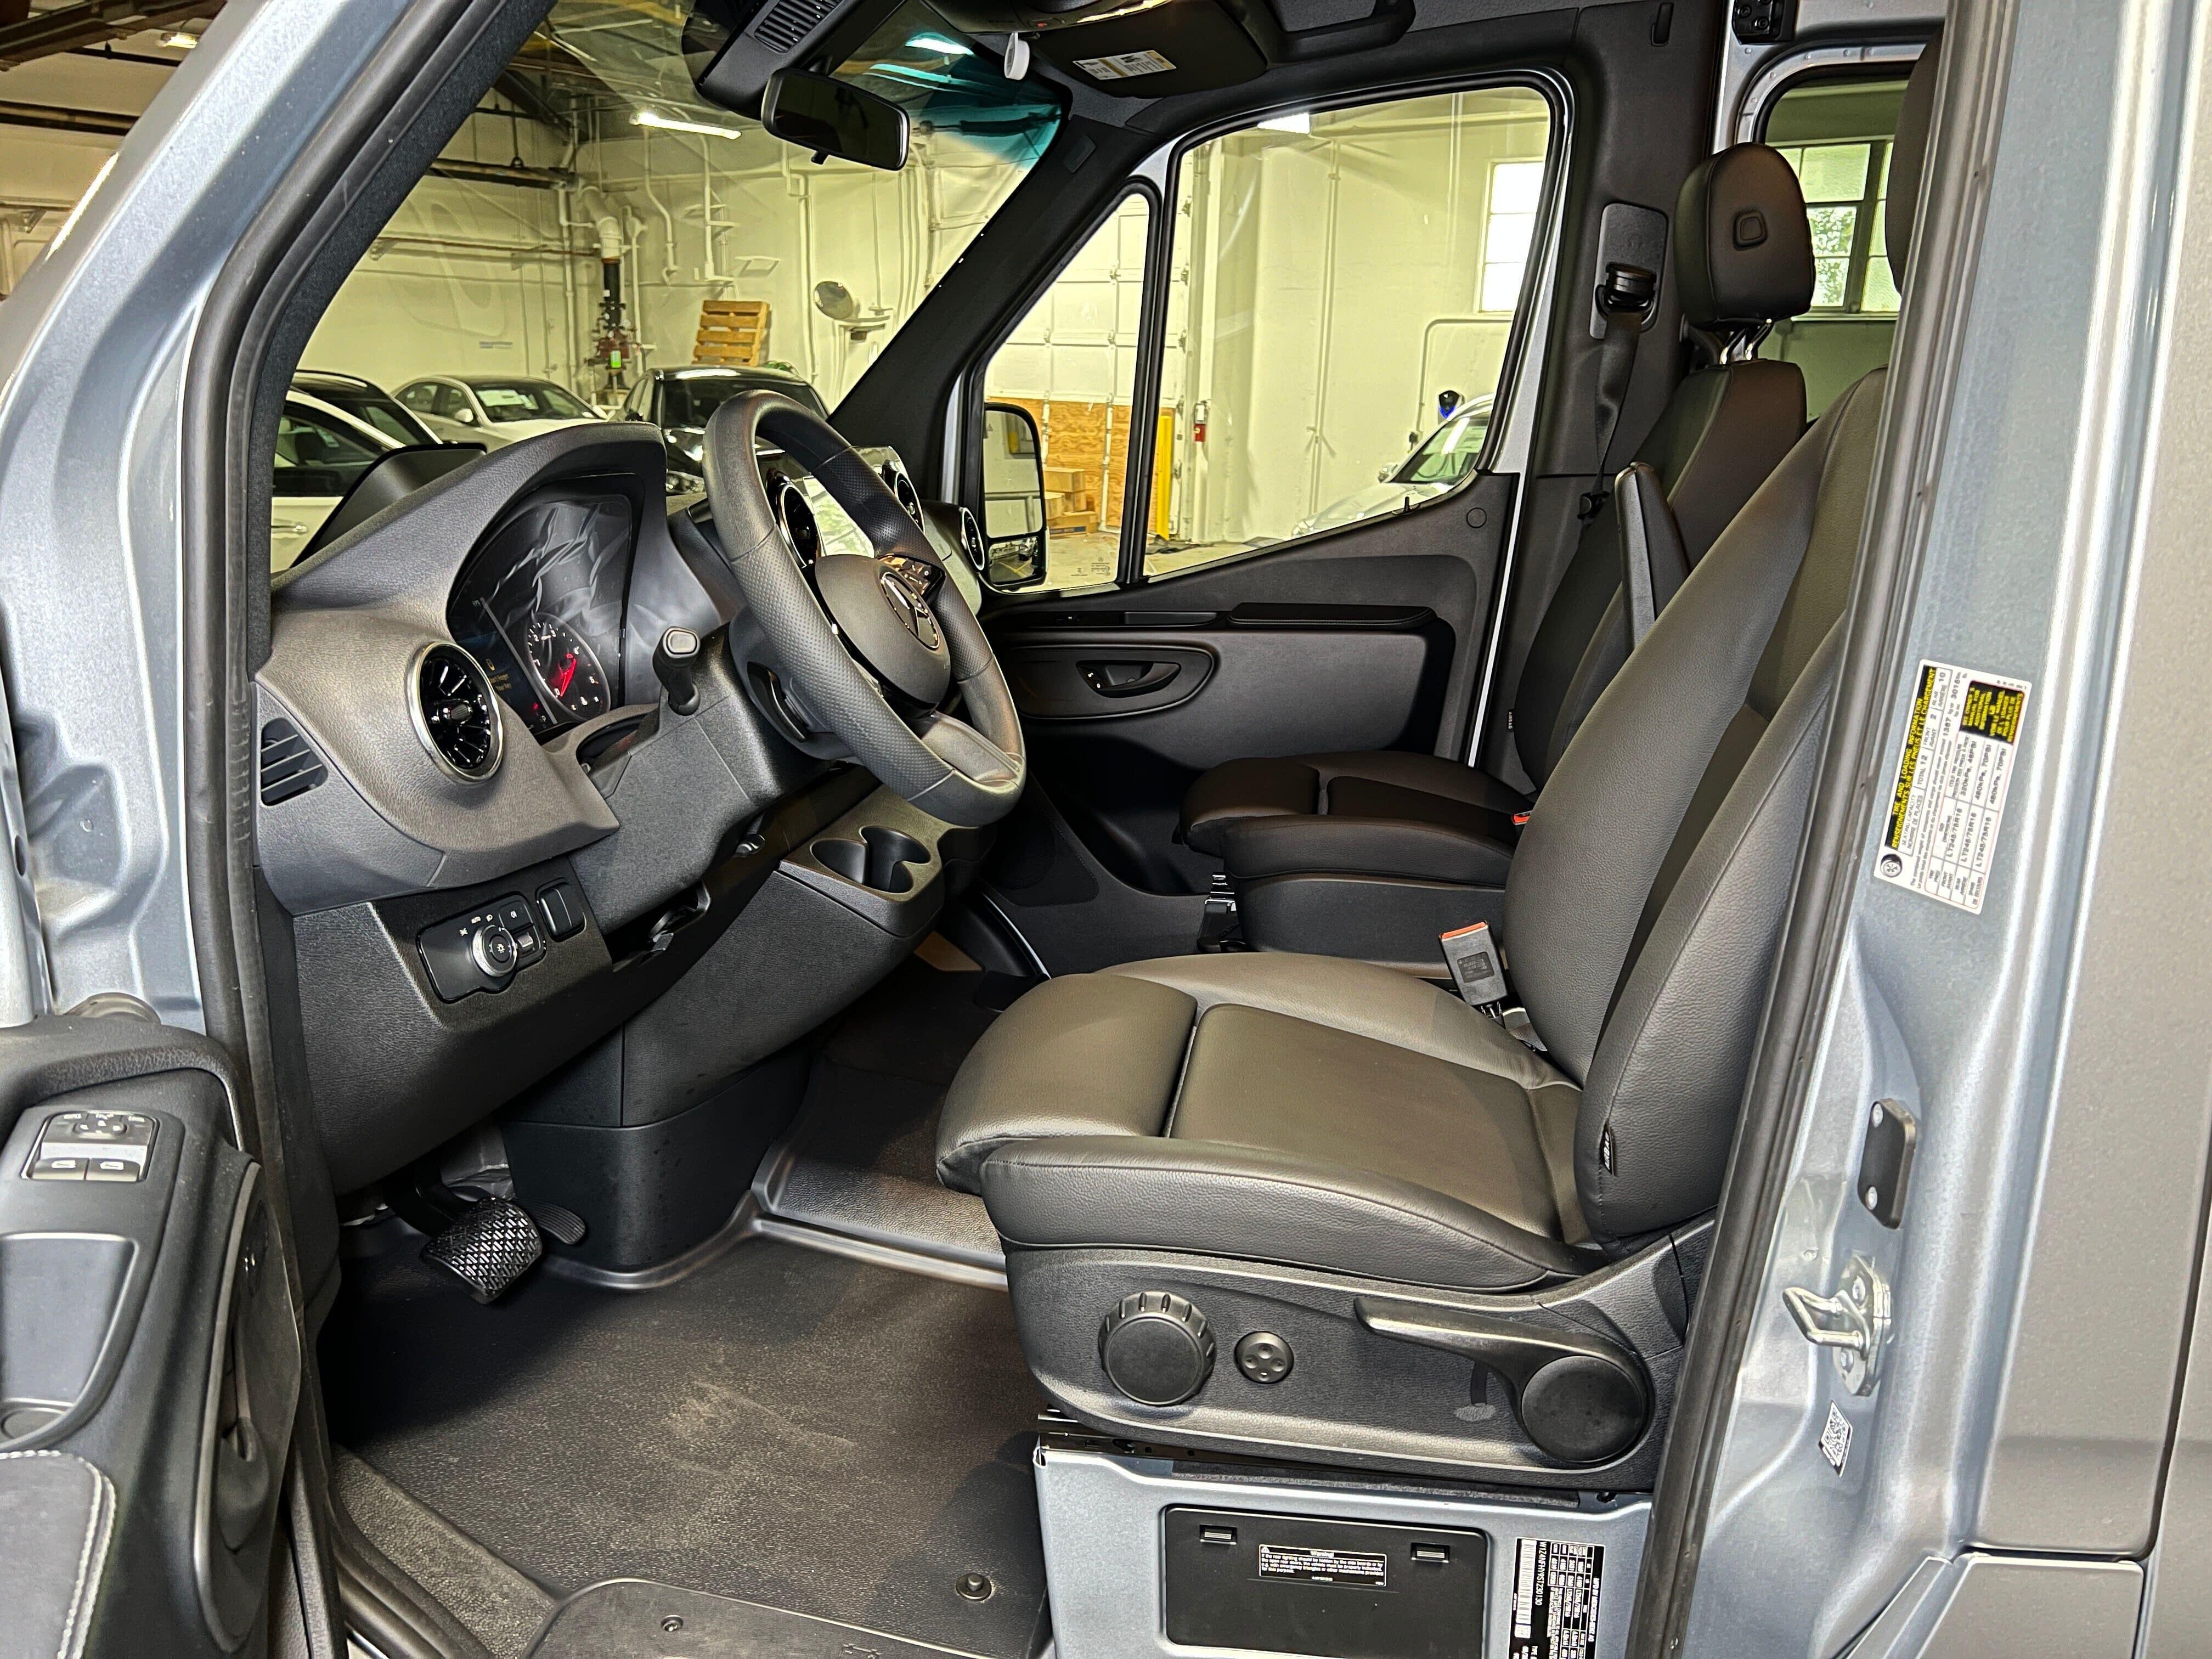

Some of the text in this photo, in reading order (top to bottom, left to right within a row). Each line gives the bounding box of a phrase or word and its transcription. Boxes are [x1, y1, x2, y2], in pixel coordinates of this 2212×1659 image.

[1938, 672, 1946, 682] 10
[1892, 697, 1923, 815] TIRE AND LOADING INFORMATION
[1920, 754, 1928, 765] 12
